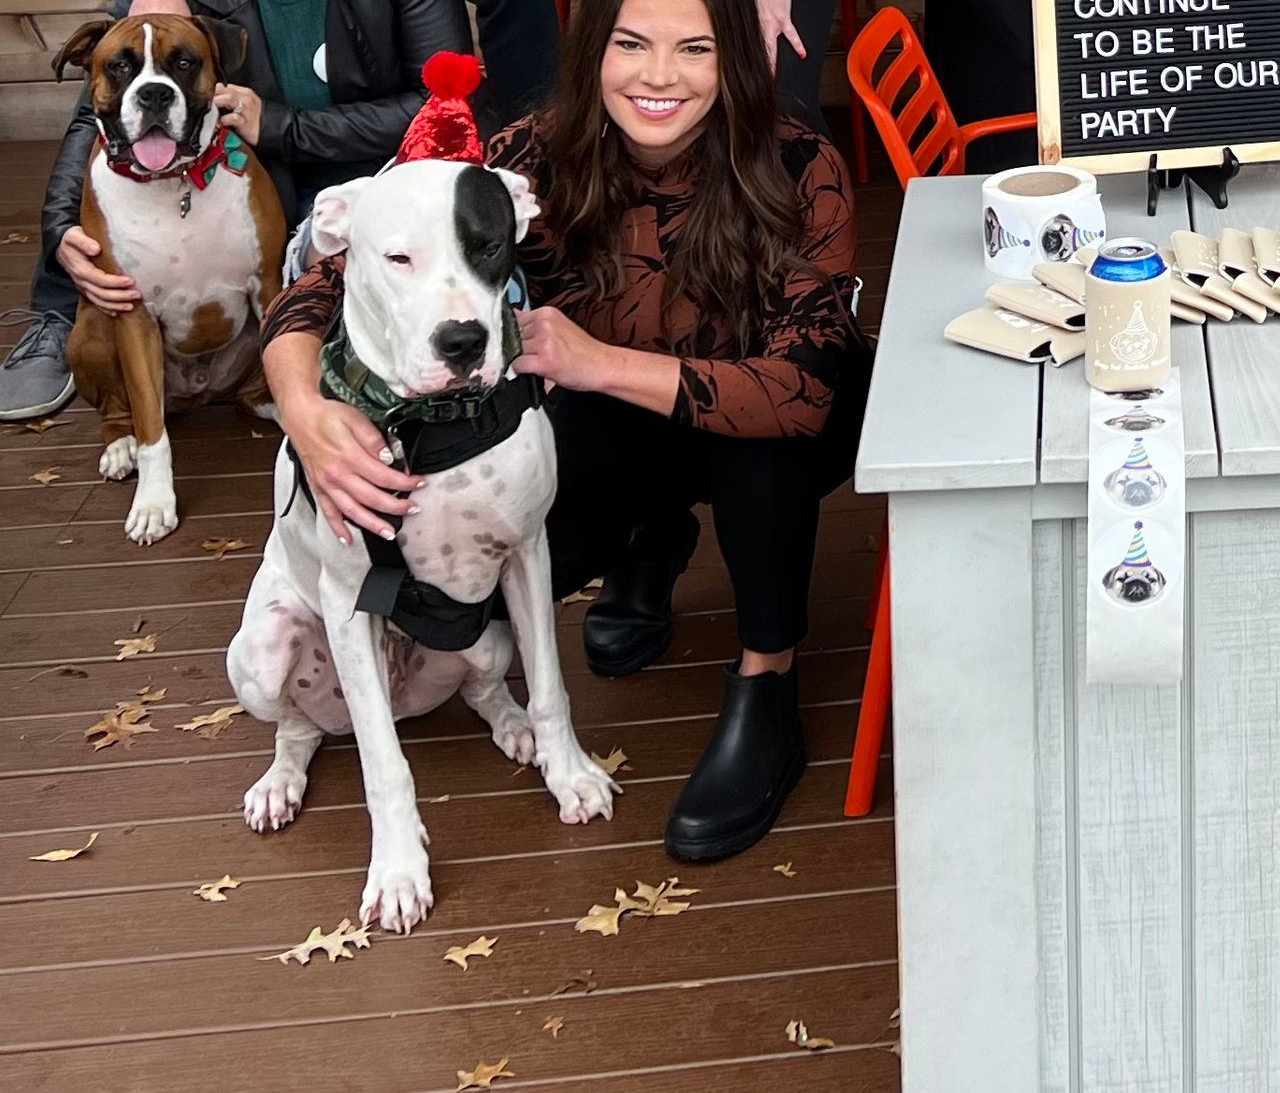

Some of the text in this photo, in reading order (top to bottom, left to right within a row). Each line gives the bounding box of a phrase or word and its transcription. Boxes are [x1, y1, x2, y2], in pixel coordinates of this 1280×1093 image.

[1073, 23, 1246, 58] TO BE THE
[1081, 60, 1280, 99] LIFE OF OUR
[1080, 106, 1177, 139] PARTY
